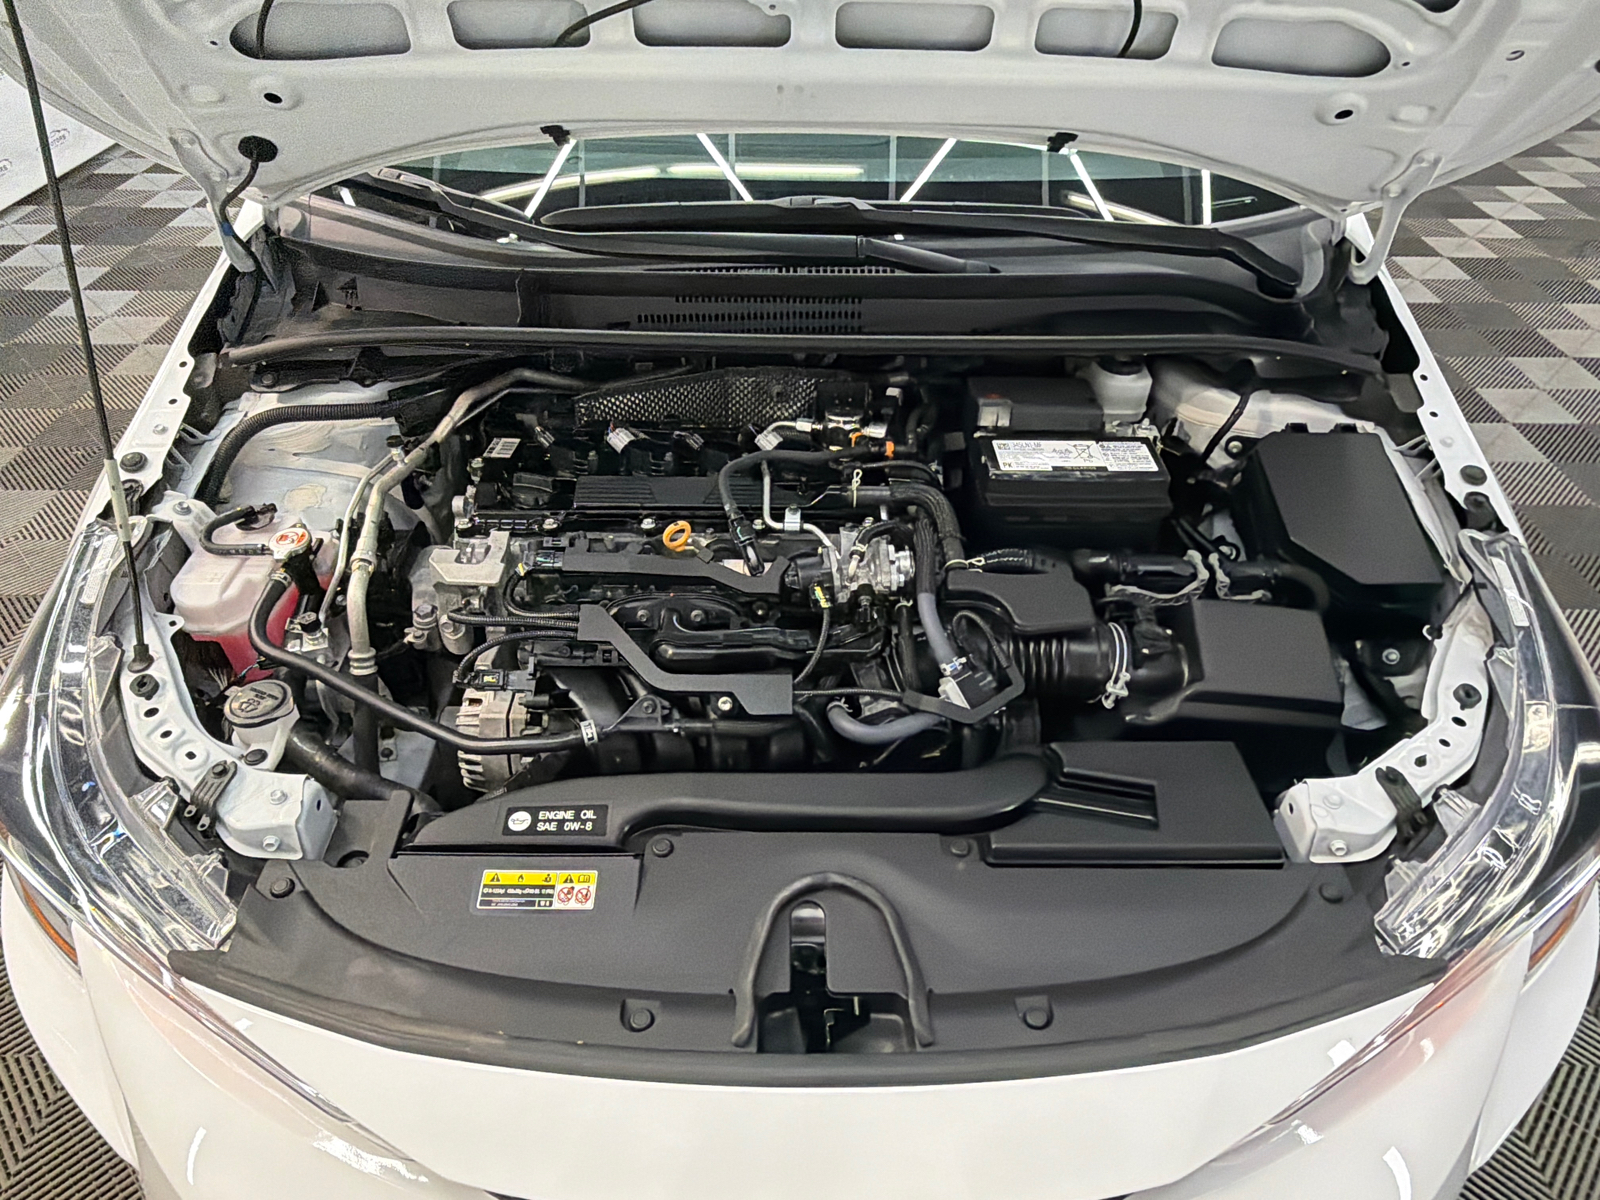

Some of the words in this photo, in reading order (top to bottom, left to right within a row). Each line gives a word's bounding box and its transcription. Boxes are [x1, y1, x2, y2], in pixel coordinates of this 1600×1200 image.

[538, 810, 575, 820] ENGINE
[580, 809, 597, 819] OIL
[536, 822, 558, 831] SAE
[563, 821, 593, 831] 0W-8
